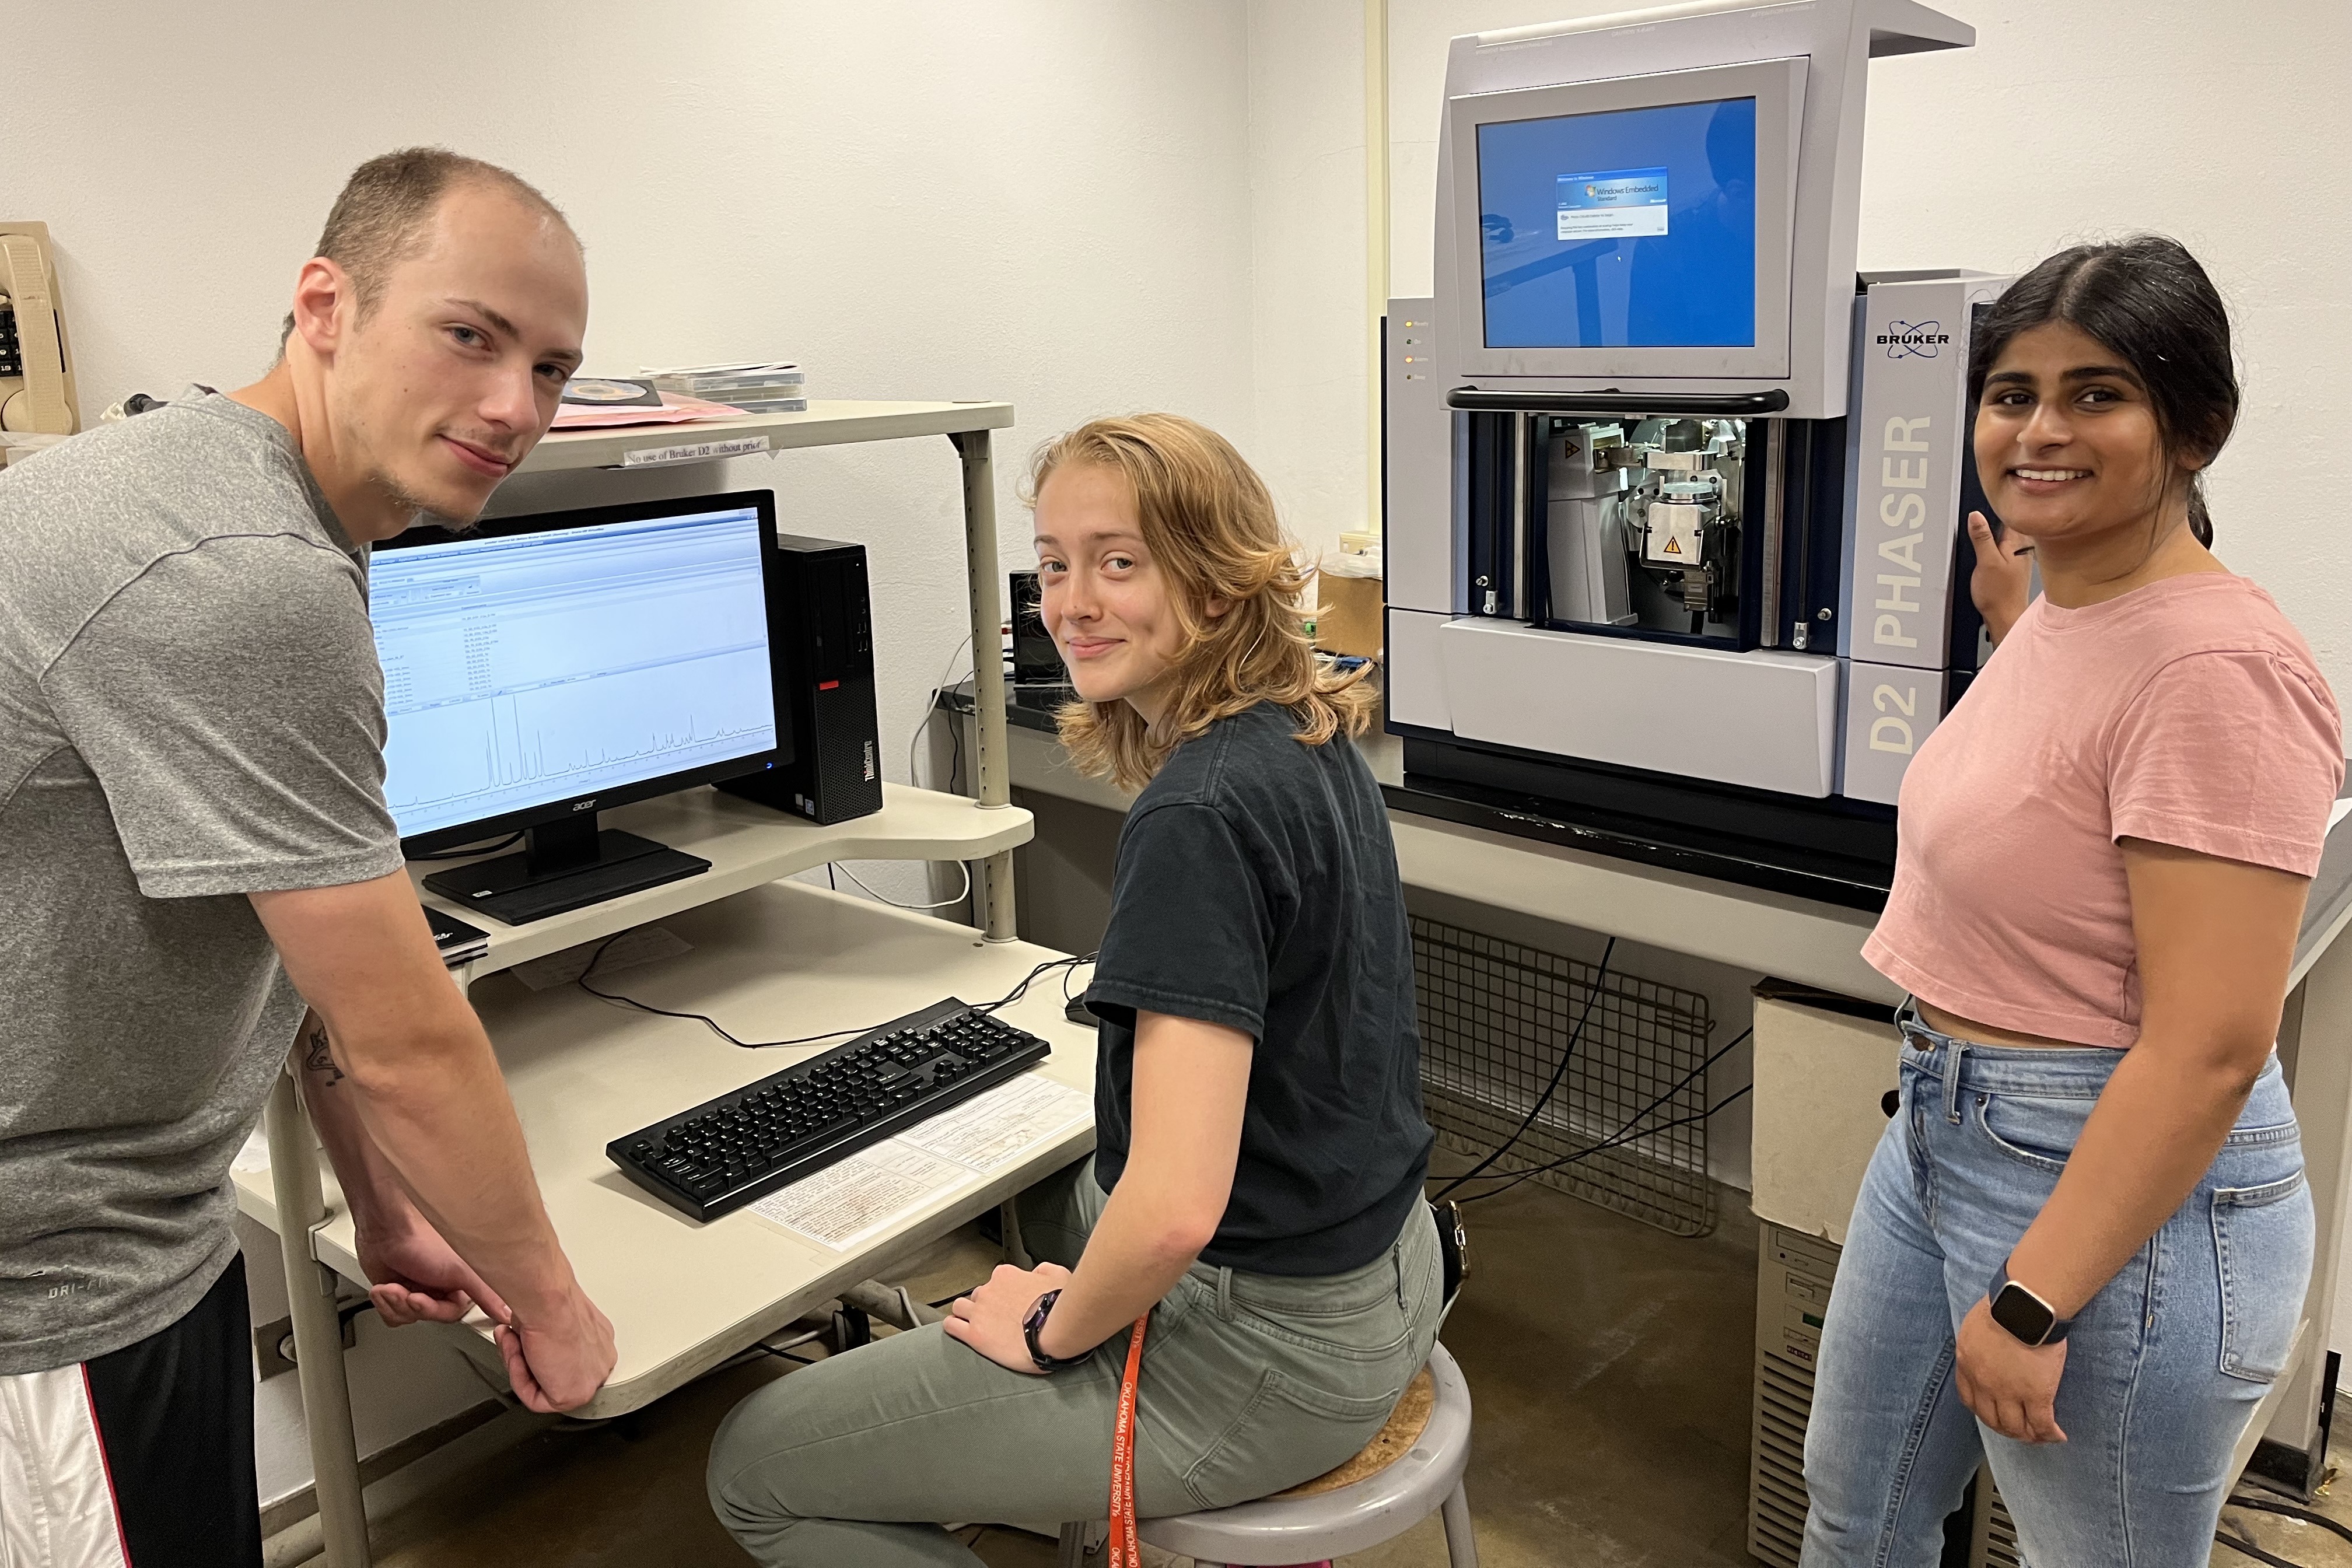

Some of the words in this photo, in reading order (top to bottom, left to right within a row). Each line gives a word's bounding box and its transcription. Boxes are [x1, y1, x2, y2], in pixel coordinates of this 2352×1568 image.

[1597, 187, 1625, 195] Windows
[1625, 184, 1659, 194] Embedded
[1876, 334, 1950, 345] BRUKER
[628, 454, 641, 464] No
[658, 452, 668, 460] of
[668, 448, 695, 459] Bruker
[698, 446, 710, 456] D2
[713, 443, 741, 454] without
[742, 440, 761, 453] prior
[1874, 415, 1931, 649] PHASER
[1869, 684, 1916, 755] D2
[573, 799, 597, 811] acer
[1117, 1381, 1133, 1434] OKLAHOMA
[1114, 1436, 1125, 1463] STATE
[1124, 1501, 1133, 1526] STATE
[1124, 1526, 1138, 1568] OKLAHOMA
